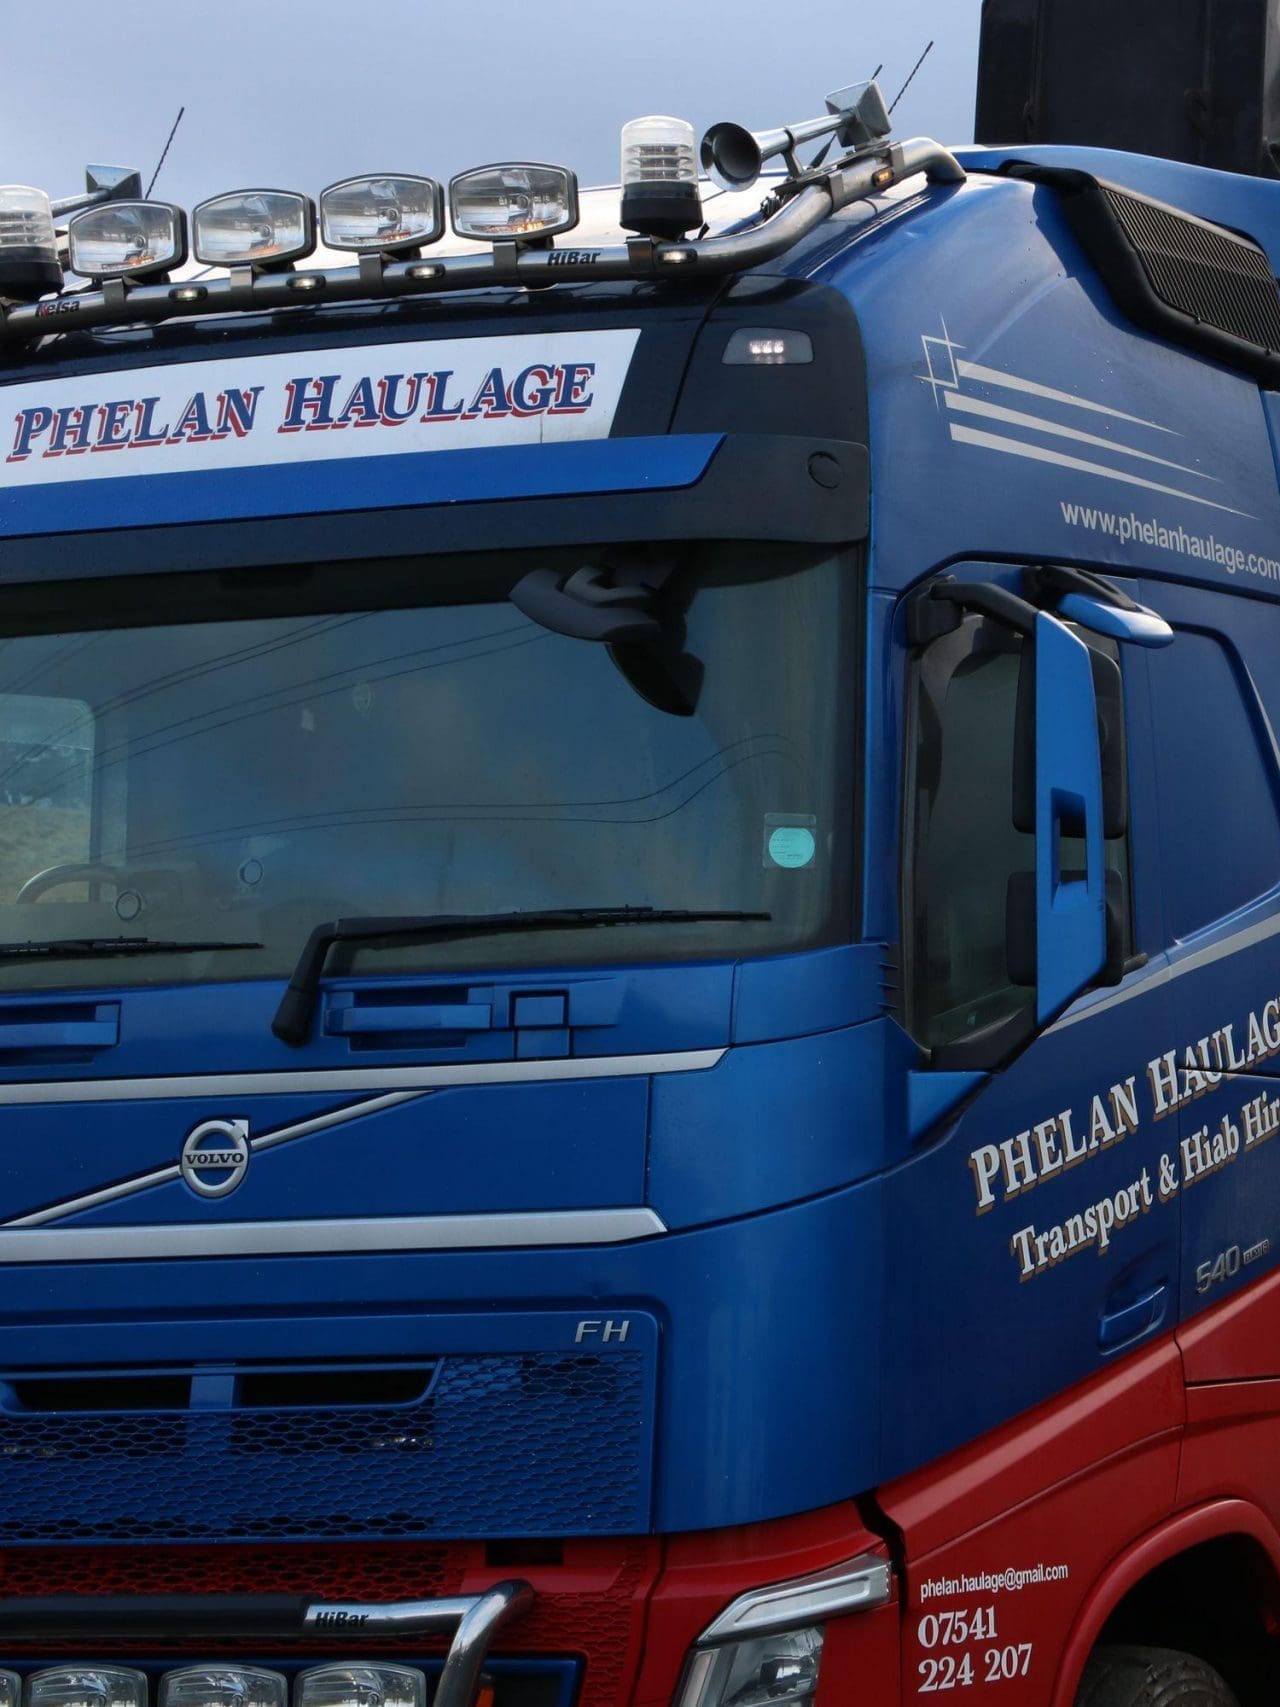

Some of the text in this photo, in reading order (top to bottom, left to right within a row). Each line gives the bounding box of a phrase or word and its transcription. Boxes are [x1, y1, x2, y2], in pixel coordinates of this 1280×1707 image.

[547, 251, 601, 266] HiBar
[36, 300, 80, 318] Kelsa
[6, 363, 596, 463] PHELAN HAULAGE
[185, 1153, 244, 1164] VOLVO
[969, 1076, 1139, 1215] PHELAN
[1012, 1167, 1154, 1282] Transport
[1158, 1153, 1180, 1201] &
[1180, 1114, 1241, 1189] Hiab
[1196, 1246, 1240, 1293] 540
[575, 1320, 630, 1343] FH
[920, 1564, 1069, 1603] phelan.haulage@gmail.com
[315, 1611, 369, 1627] HiBar
[918, 1606, 998, 1648] 07541
[917, 1643, 1033, 1693] 224 207
